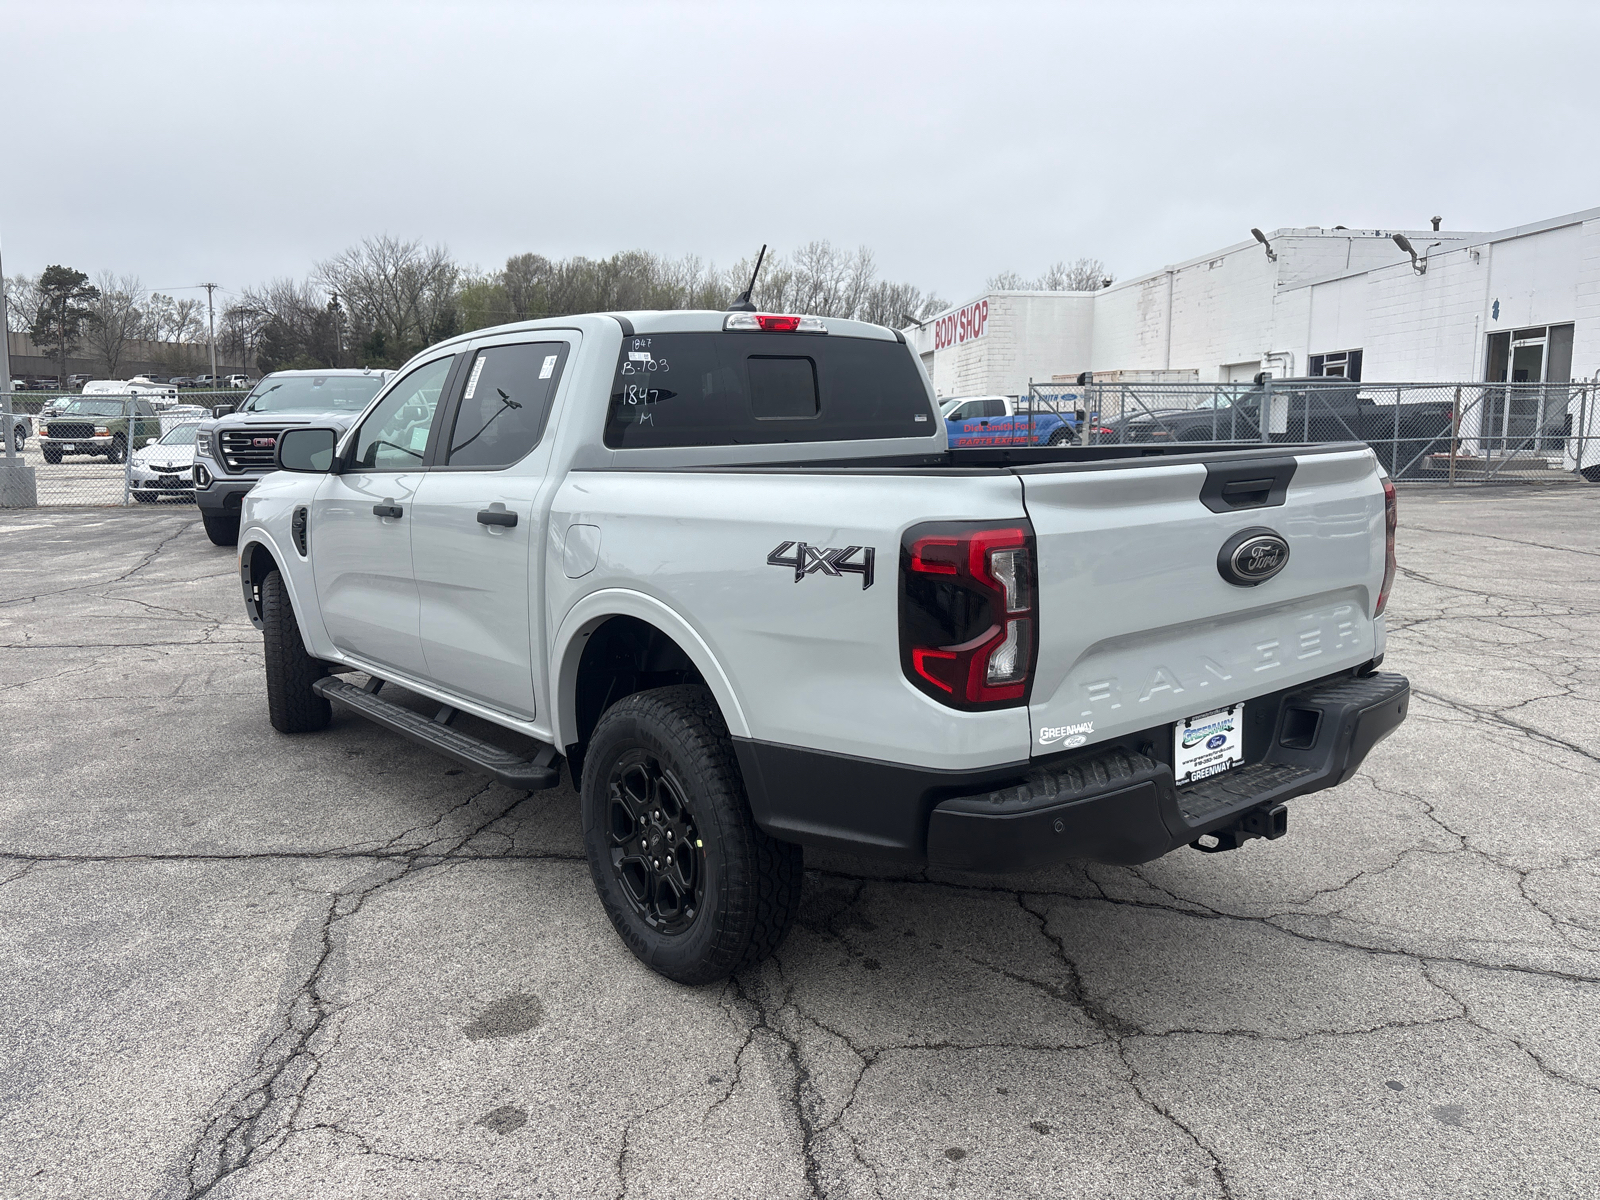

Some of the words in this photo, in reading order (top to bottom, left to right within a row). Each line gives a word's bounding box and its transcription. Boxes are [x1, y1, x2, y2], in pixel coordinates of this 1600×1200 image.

[623, 384, 659, 406] 1847
[1020, 395, 1036, 403] DIK
[639, 412, 654, 427] M
[963, 423, 984, 432] Dick
[986, 422, 1014, 432] Smith
[253, 437, 277, 447] GM
[958, 438, 992, 446] PARTS
[994, 436, 1039, 445] EXPRES
[1248, 545, 1280, 571] Ford
[1079, 617, 1365, 717] RANGER
[1040, 721, 1093, 739] GREENWAY
[1183, 718, 1234, 743] GREENWAY
[1191, 760, 1231, 782] GREENWAY
